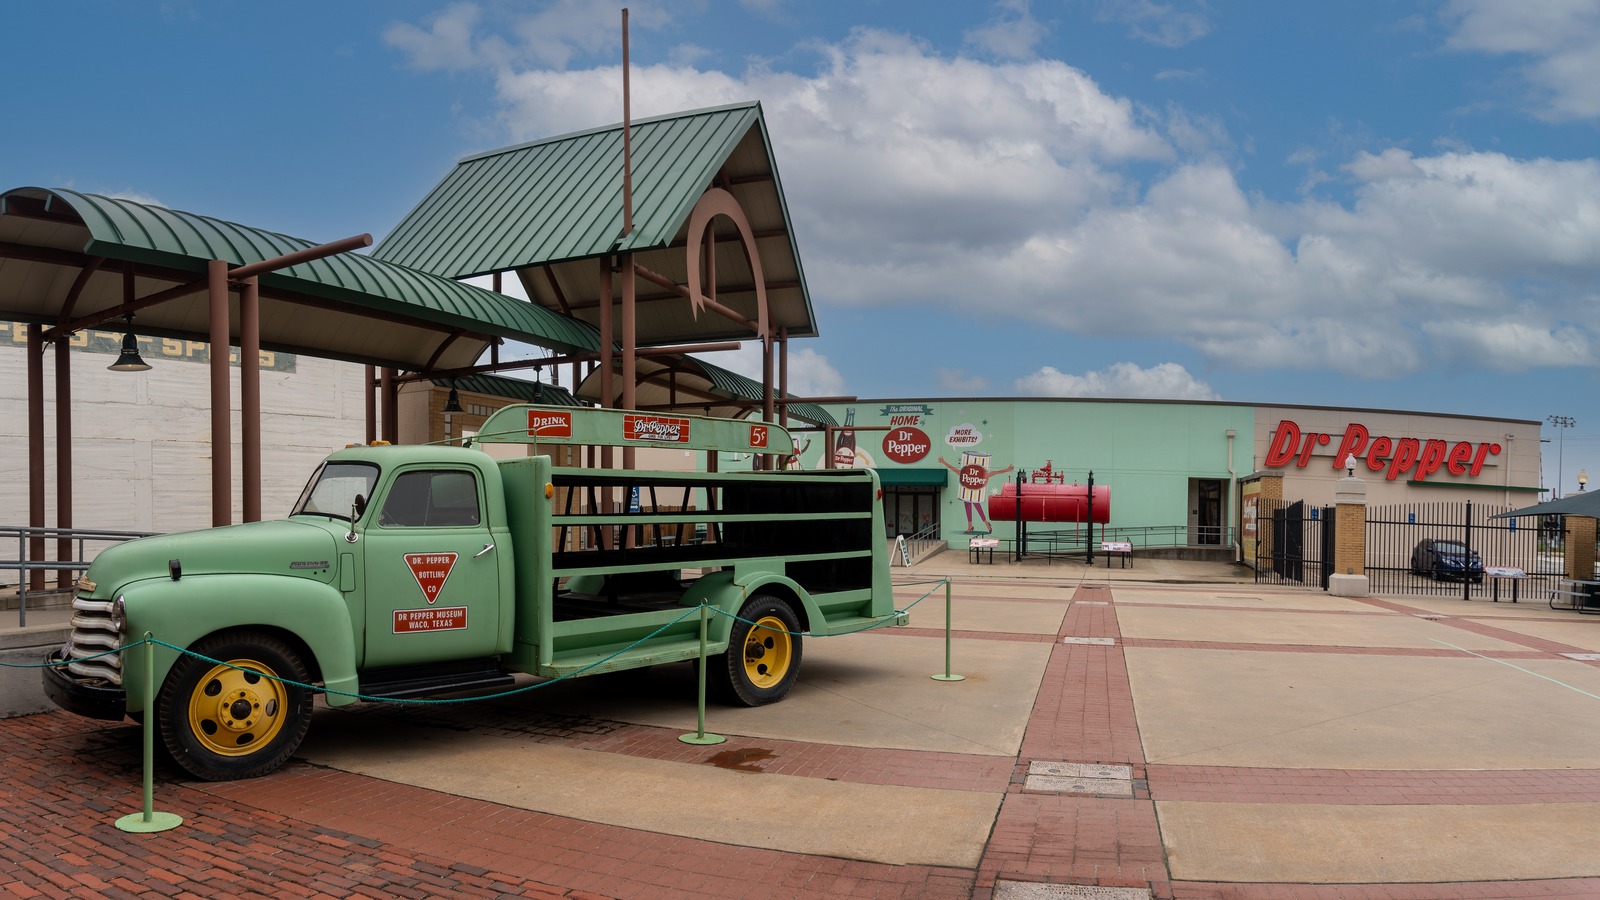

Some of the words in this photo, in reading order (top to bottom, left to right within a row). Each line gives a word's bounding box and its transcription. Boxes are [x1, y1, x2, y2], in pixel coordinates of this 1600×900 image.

[533, 416, 567, 427] DRINK
[890, 415, 920, 426] HOME
[634, 419, 649, 433] Dr
[648, 420, 681, 436] Pepper
[899, 430, 913, 441] Dr
[887, 440, 927, 457] Pepper
[1332, 423, 1502, 482] Pepper
[969, 468, 979, 476] Dr
[961, 473, 987, 485] Pepper
[412, 557, 423, 565] DR.
[426, 556, 450, 564] PEPPER
[418, 571, 445, 579] BOTTLING
[427, 585, 437, 593] CO
[398, 613, 408, 621] DR
[410, 611, 434, 620] PEPPER
[436, 609, 463, 619] MUSEUM
[432, 619, 453, 628] TEXAS
